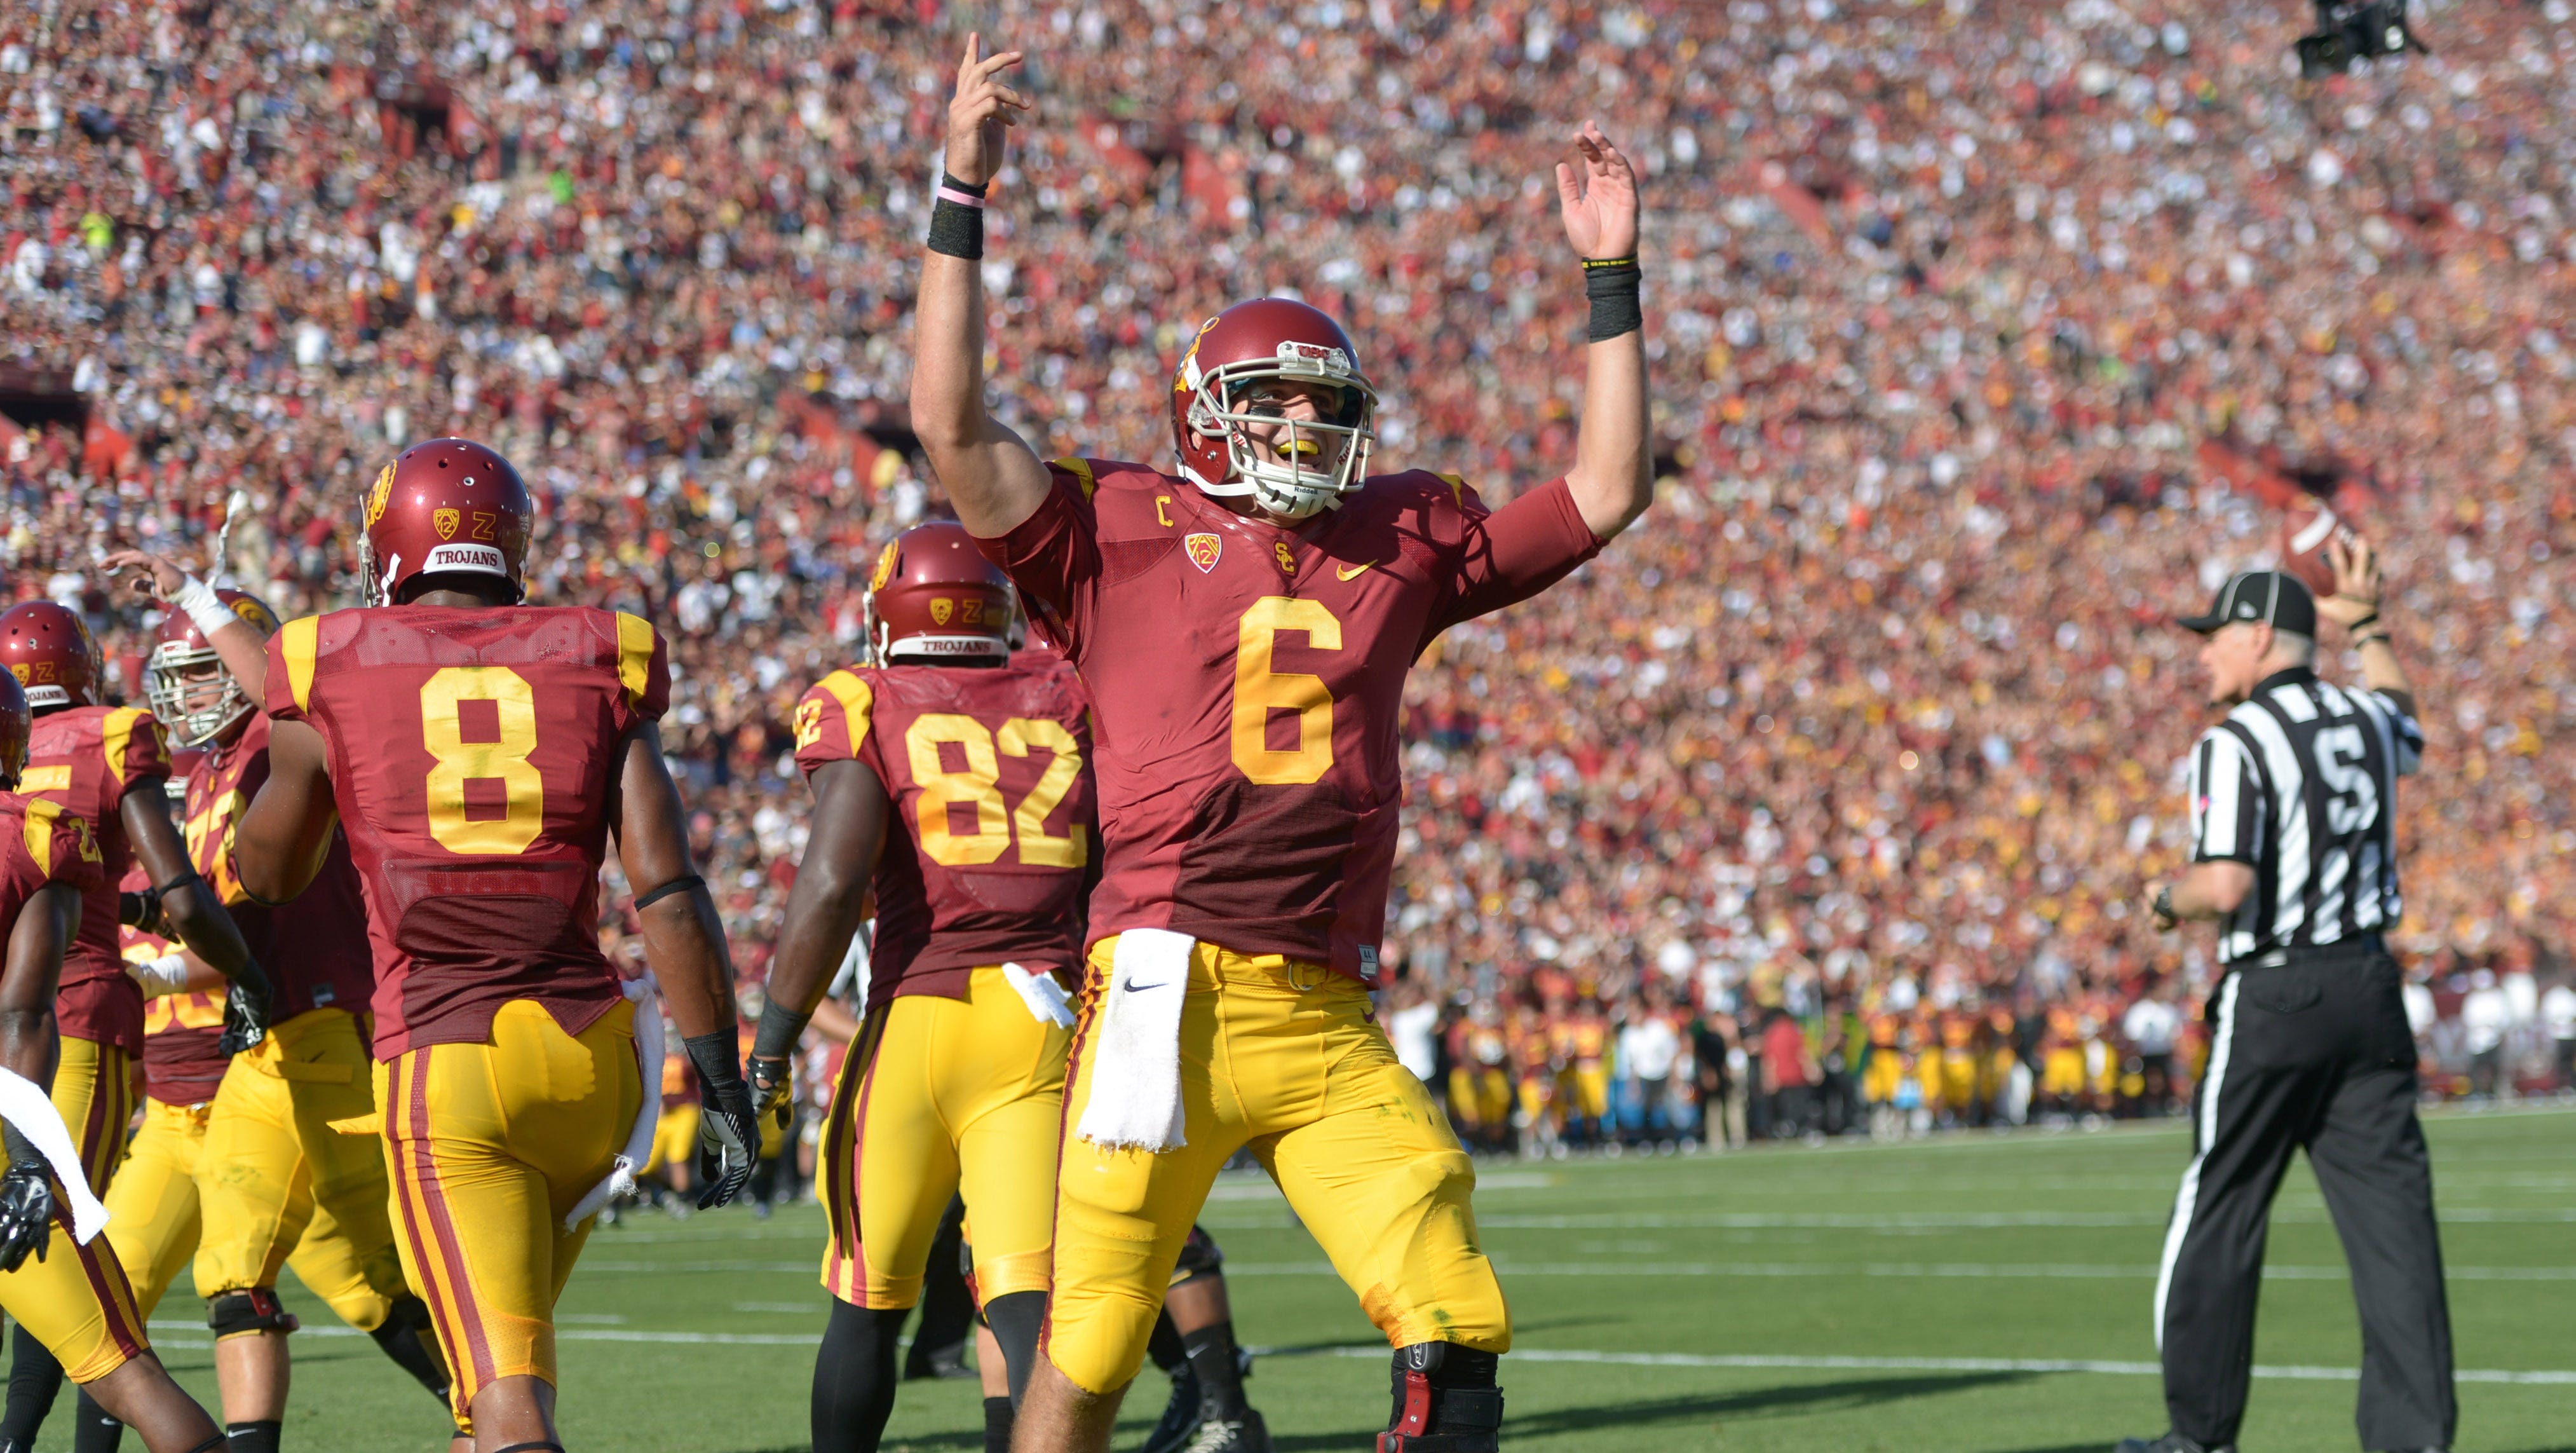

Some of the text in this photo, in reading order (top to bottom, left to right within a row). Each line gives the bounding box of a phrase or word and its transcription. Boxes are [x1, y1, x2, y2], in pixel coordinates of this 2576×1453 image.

[1294, 486, 1319, 495] Riddell
[436, 510, 458, 527] PAC
[1155, 495, 1174, 528] C
[440, 521, 452, 533] 12
[472, 511, 496, 541] Z
[1187, 535, 1219, 557] PAC
[435, 550, 498, 567] TROJANS
[1196, 549, 1213, 564] 12
[1275, 542, 1295, 574] SC
[923, 641, 992, 653] TROJANS
[26, 690, 62, 702] OJANS
[1231, 596, 1343, 785] 6
[419, 665, 544, 855] 8
[905, 713, 1088, 868] 82
